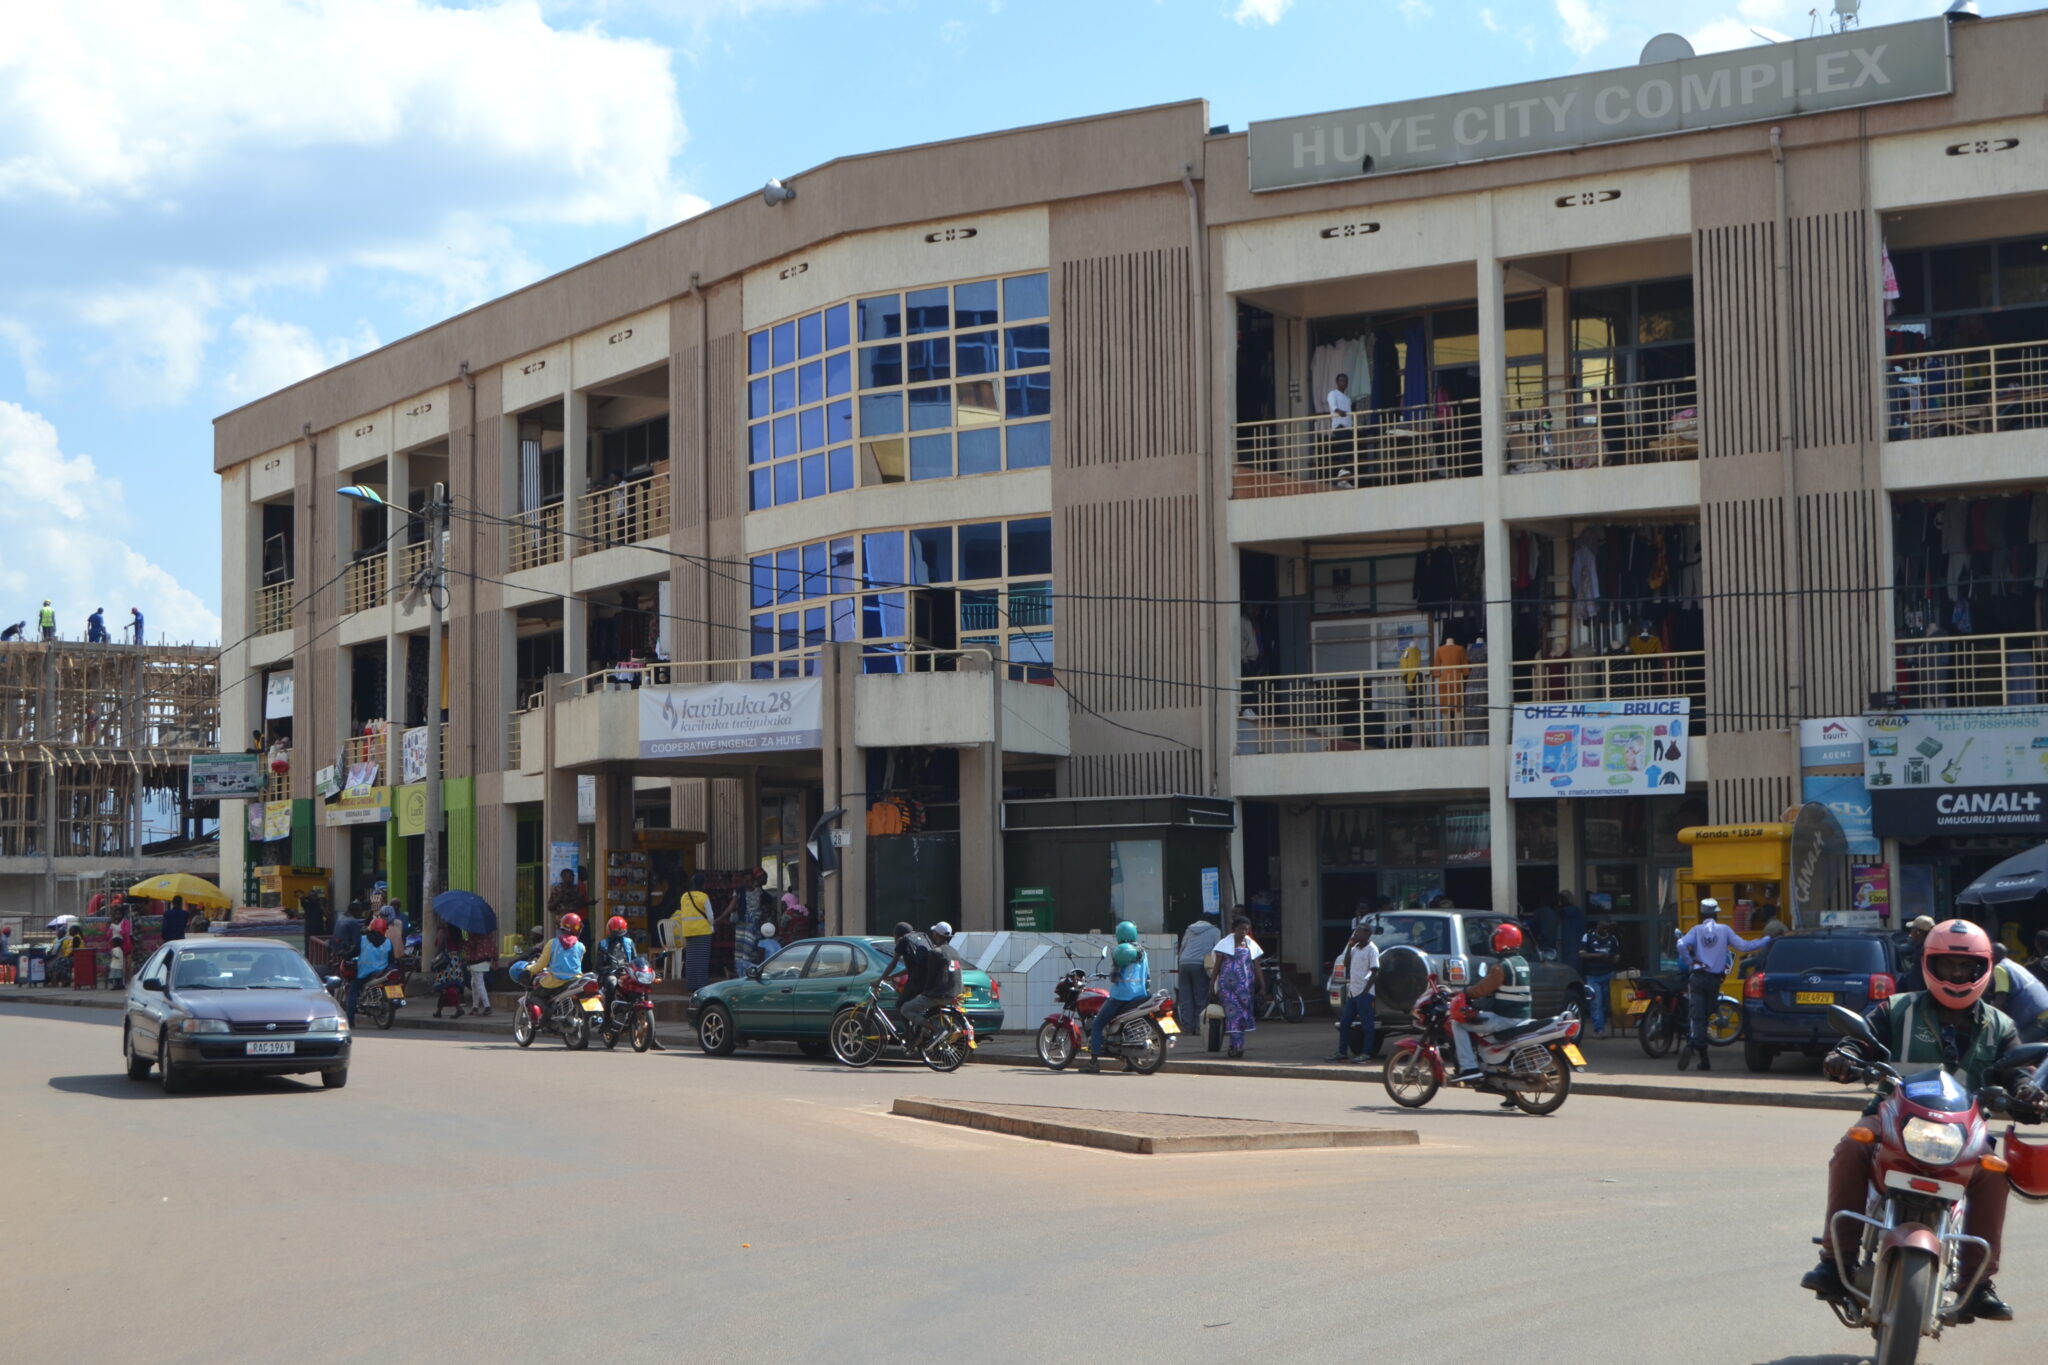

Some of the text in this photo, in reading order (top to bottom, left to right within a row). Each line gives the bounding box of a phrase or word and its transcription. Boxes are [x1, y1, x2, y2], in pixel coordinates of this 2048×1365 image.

[1292, 44, 1891, 168] HUYE CITY COMPLEX
[1524, 705, 1568, 719] CHEZ
[1624, 701, 1681, 715] BRUCE
[681, 715, 792, 732] kwibuka twiyubaka
[1935, 720, 1960, 731] Tel:
[651, 735, 802, 753] COOPERATIVE INGENZI ZA HUYE
[1822, 750, 1852, 760] AGENT
[1936, 791, 2041, 814] CANAL+
[1937, 813, 2040, 825] UMUCURUZI WEMEWE
[1695, 829, 1729, 839] Kanda
